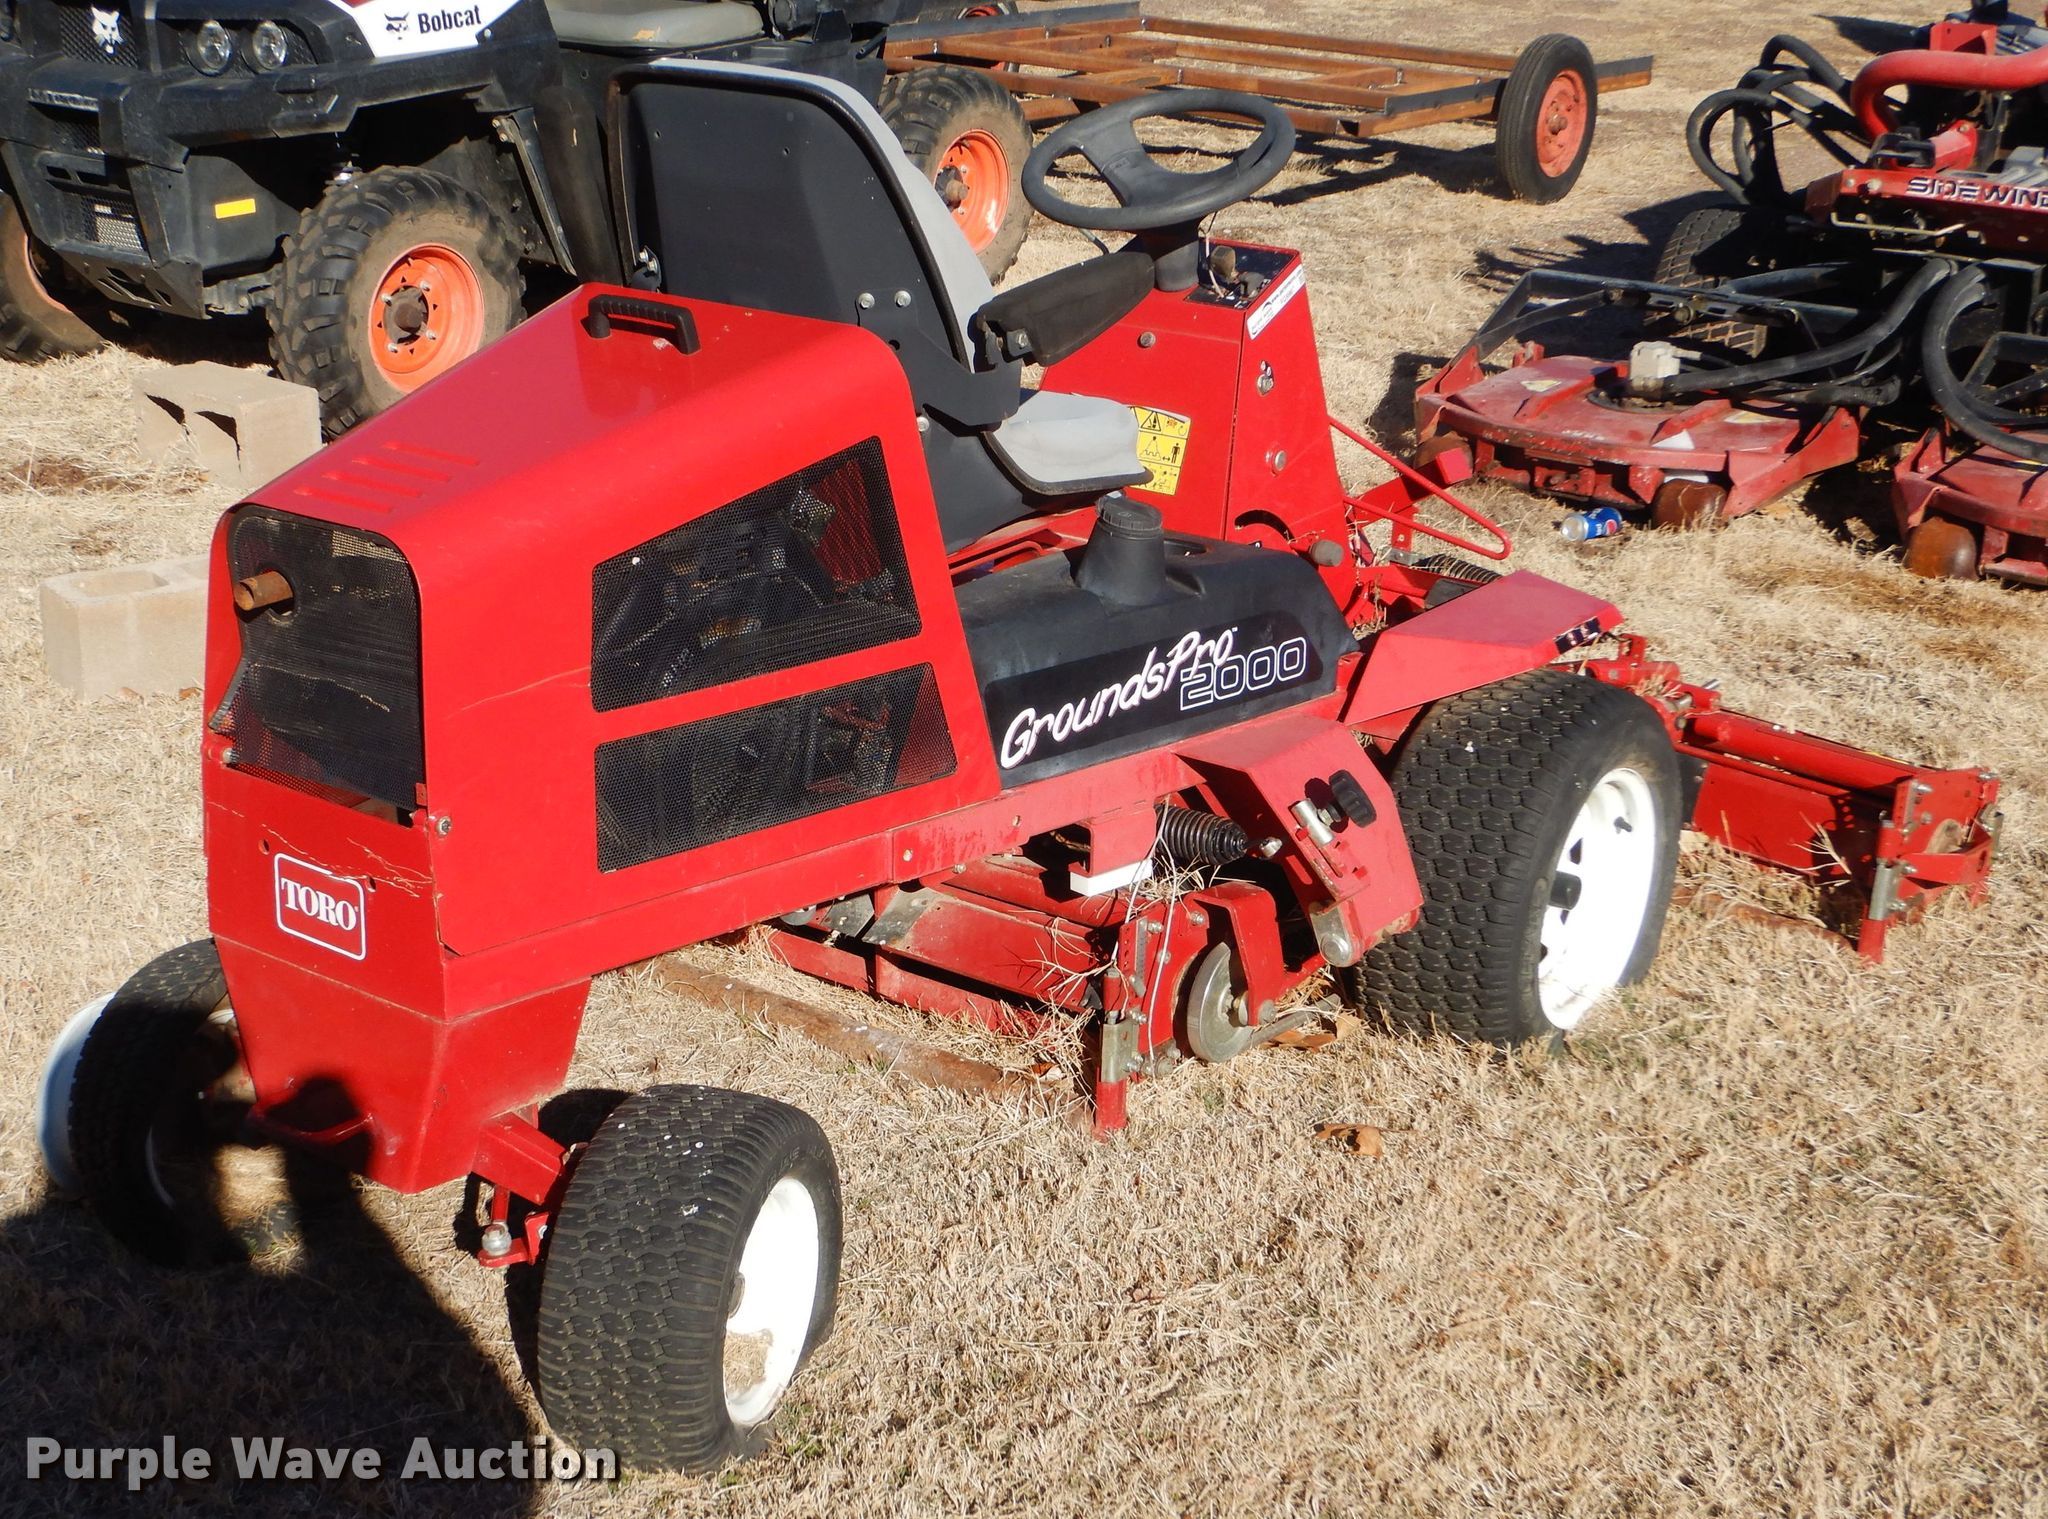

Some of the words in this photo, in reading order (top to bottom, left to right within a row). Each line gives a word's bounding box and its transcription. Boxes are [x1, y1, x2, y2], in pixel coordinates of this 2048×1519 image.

[418, 5, 481, 34] Bobcat
[1001, 631, 1234, 769] GroundsPro
[1180, 637, 1306, 711] 2000
[281, 877, 357, 930] TORO
